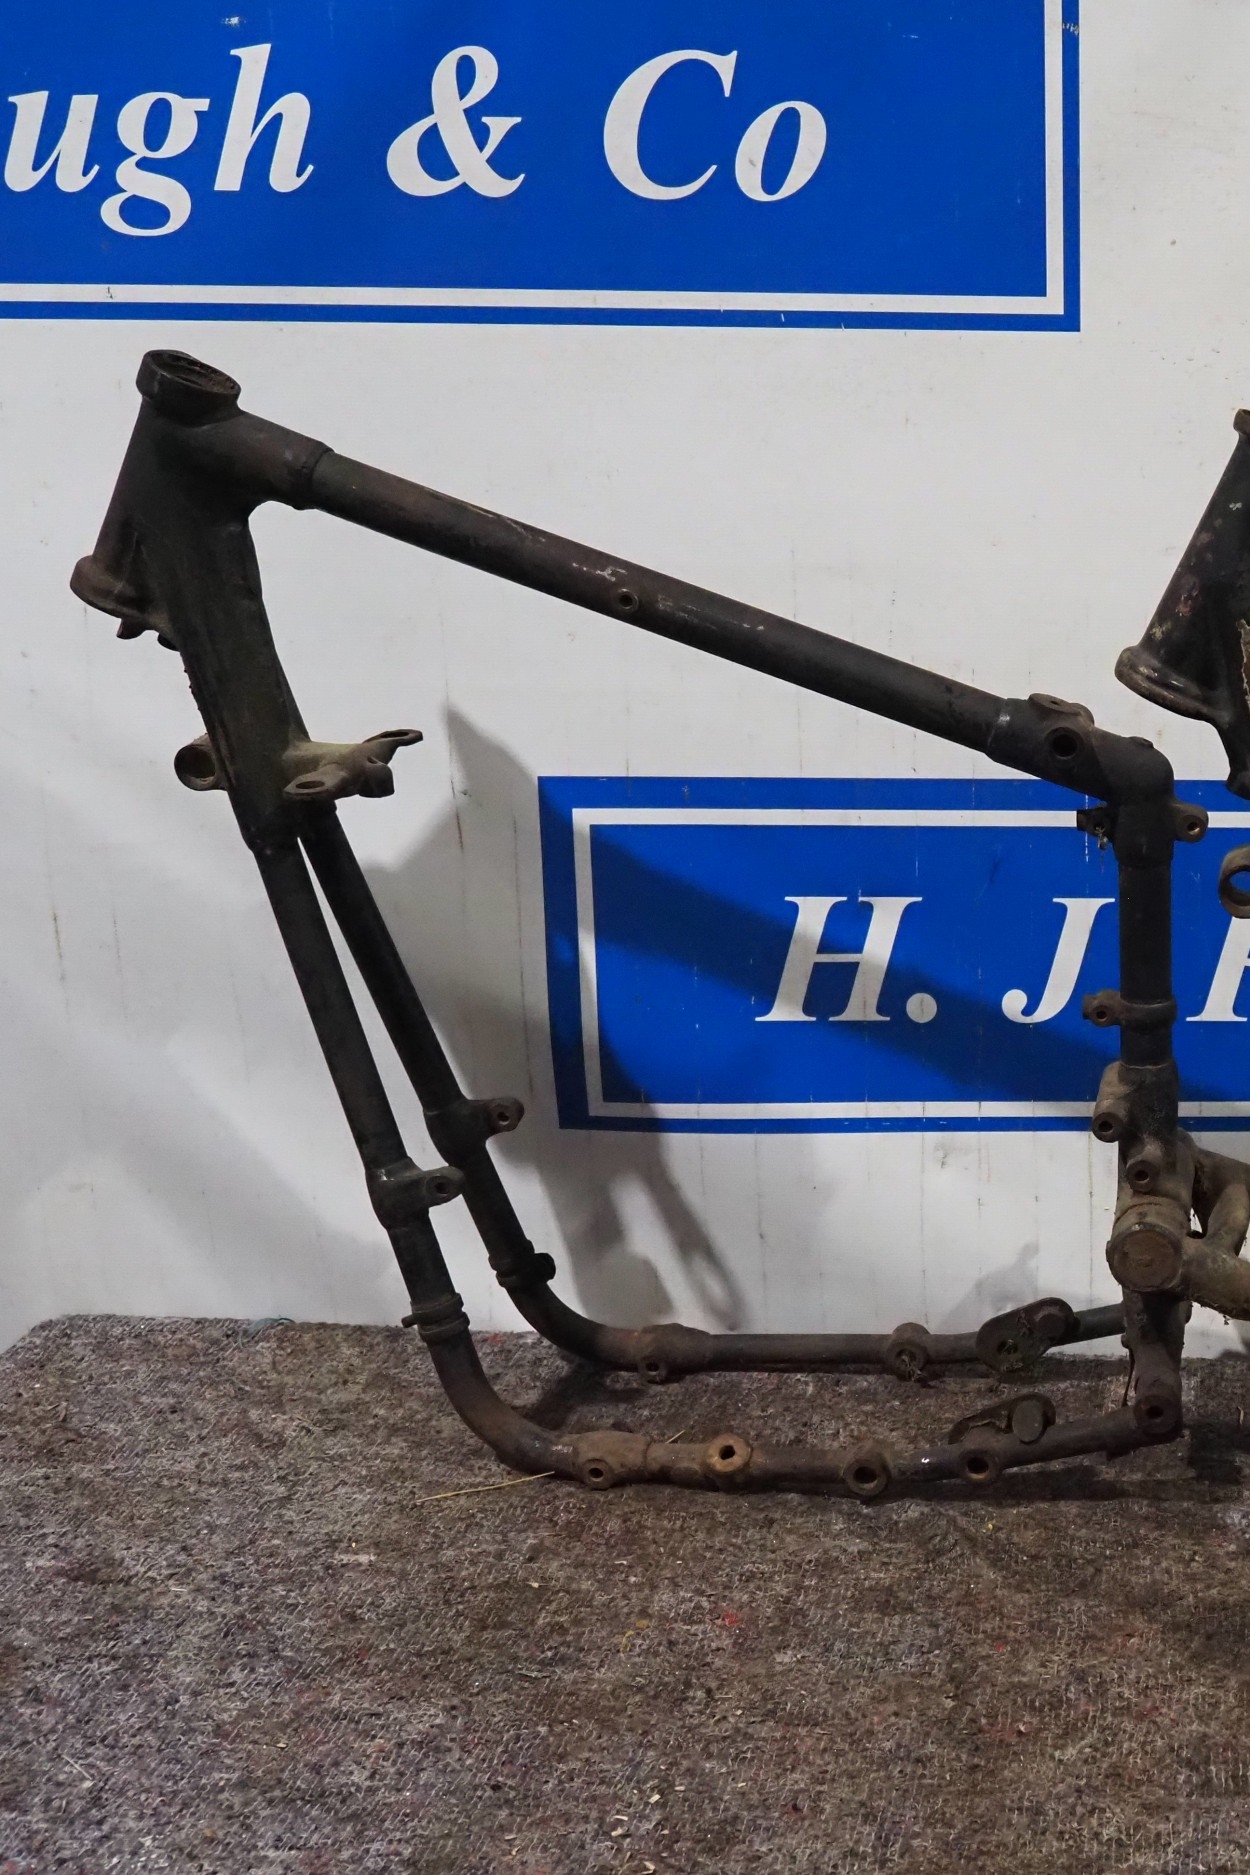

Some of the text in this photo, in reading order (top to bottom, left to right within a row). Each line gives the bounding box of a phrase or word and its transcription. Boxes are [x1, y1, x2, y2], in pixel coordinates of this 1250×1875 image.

[386, 45, 525, 198] &
[603, 49, 827, 202] Co
[754, 896, 938, 1024] H.
[1001, 897, 1116, 1024] J
